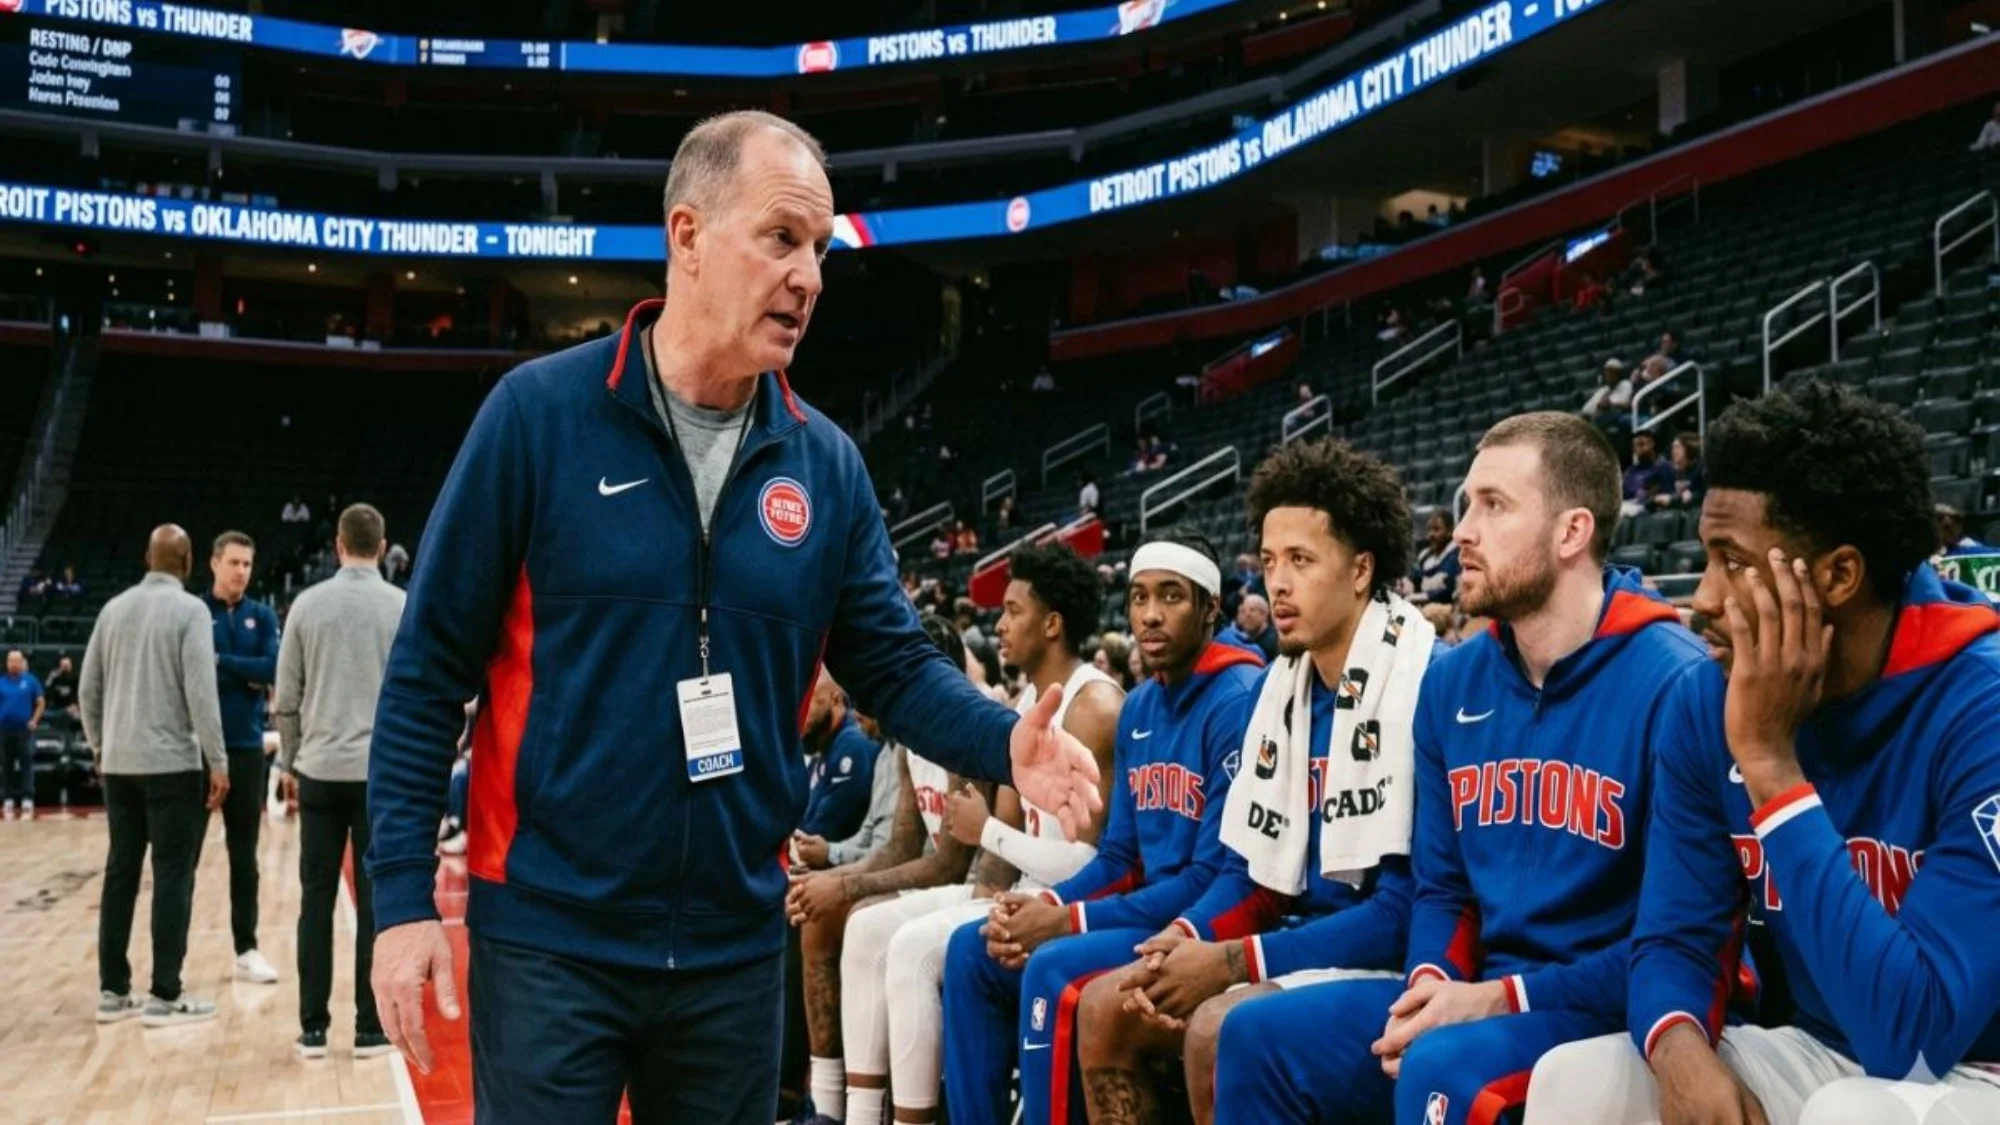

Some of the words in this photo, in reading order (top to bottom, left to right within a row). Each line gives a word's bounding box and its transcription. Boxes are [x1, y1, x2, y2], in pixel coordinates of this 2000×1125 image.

[29, 28, 90, 54] RESTING
[92, 37, 100, 55] /
[102, 39, 133, 58] DNP
[136, 7, 158, 28] vs
[162, 5, 252, 41] THUNDER
[868, 30, 945, 63] PISTONS
[947, 34, 967, 55] vs
[970, 17, 1056, 51] THUNDER
[1089, 163, 1166, 213] DETROIT
[1168, 138, 1241, 193] PISTONS
[1262, 80, 1358, 158] OKLAHOMA
[1361, 53, 1406, 109] CITY
[1408, 1, 1513, 86] THUNDER
[54, 191, 157, 230] PISTONS
[162, 209, 186, 233] vs
[191, 205, 319, 245] OKLAHOMA
[323, 217, 374, 250] CITY
[378, 222, 479, 253] THUNDER
[504, 226, 597, 257] TONIGHT
[697, 753, 734, 773] COACH
[1448, 758, 1626, 850] PISTONS
